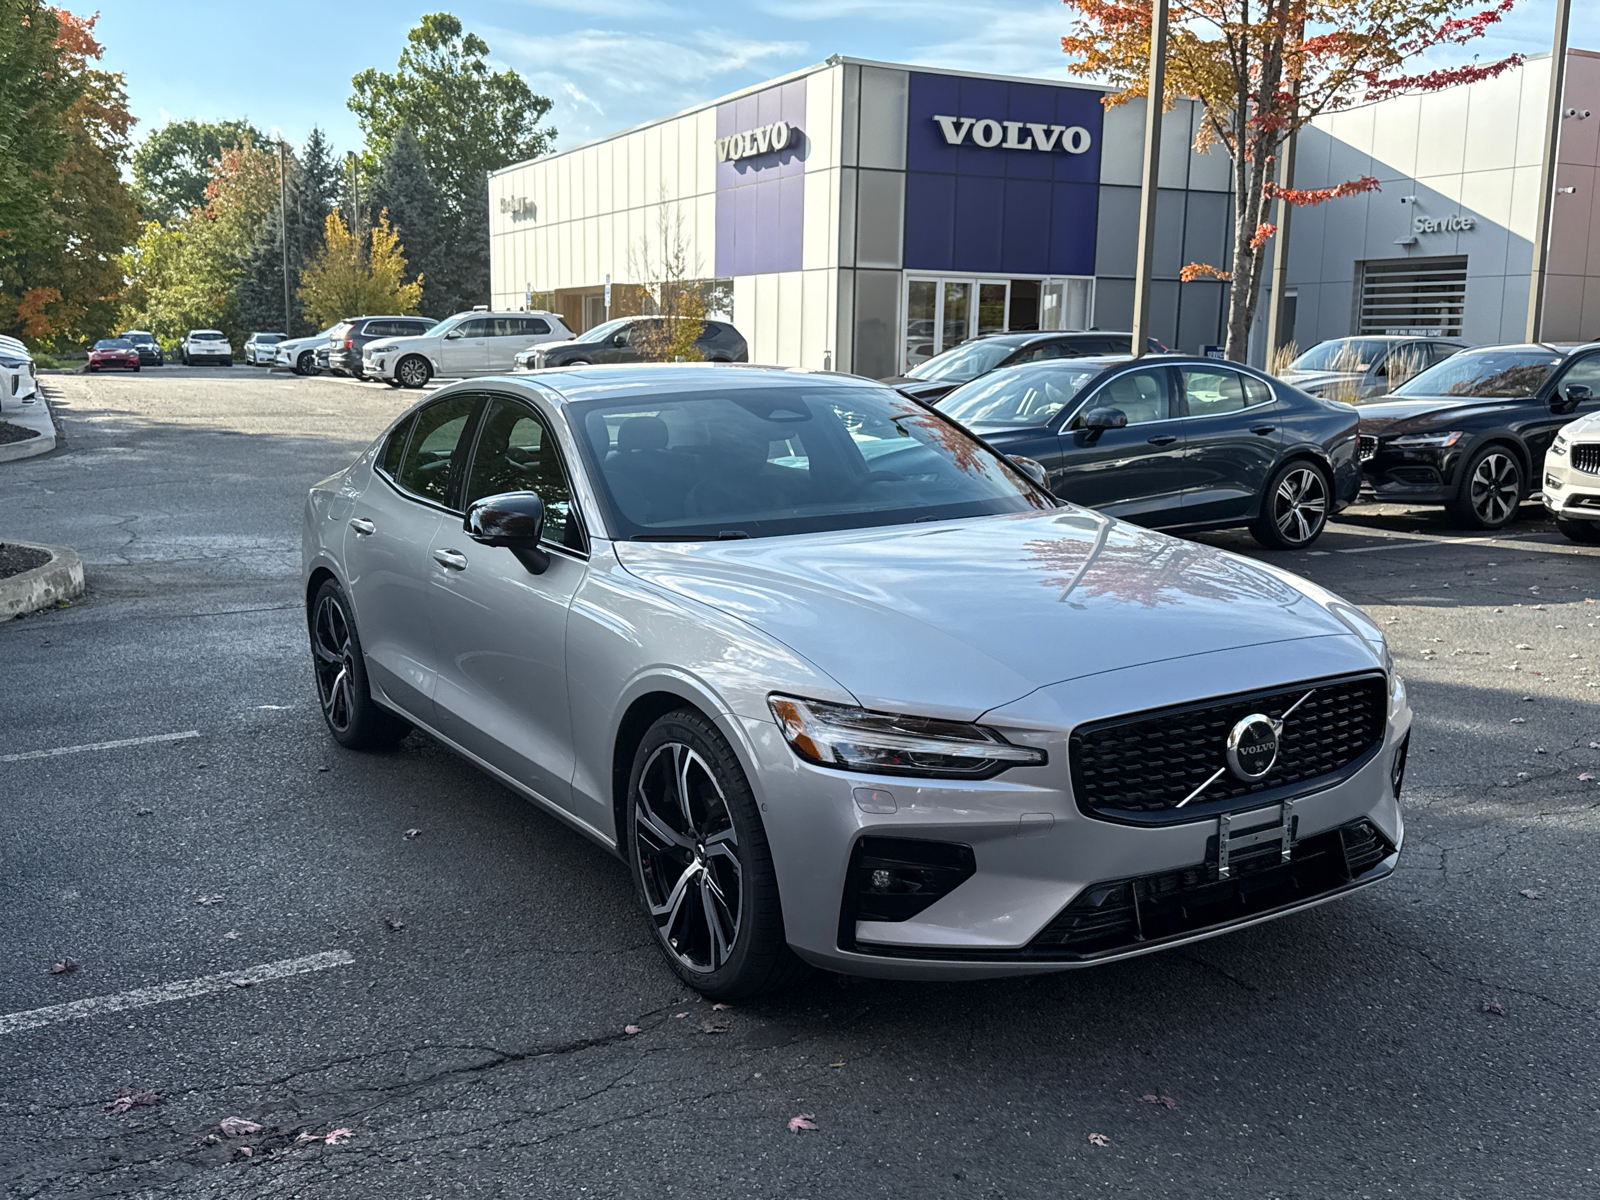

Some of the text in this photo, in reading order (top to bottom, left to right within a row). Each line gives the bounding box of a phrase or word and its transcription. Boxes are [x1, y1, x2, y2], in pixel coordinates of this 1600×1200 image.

[714, 121, 789, 163] VOLVO
[932, 115, 1091, 154] VOLVO
[1413, 214, 1473, 233] Service
[1240, 741, 1275, 755] VOLVO
